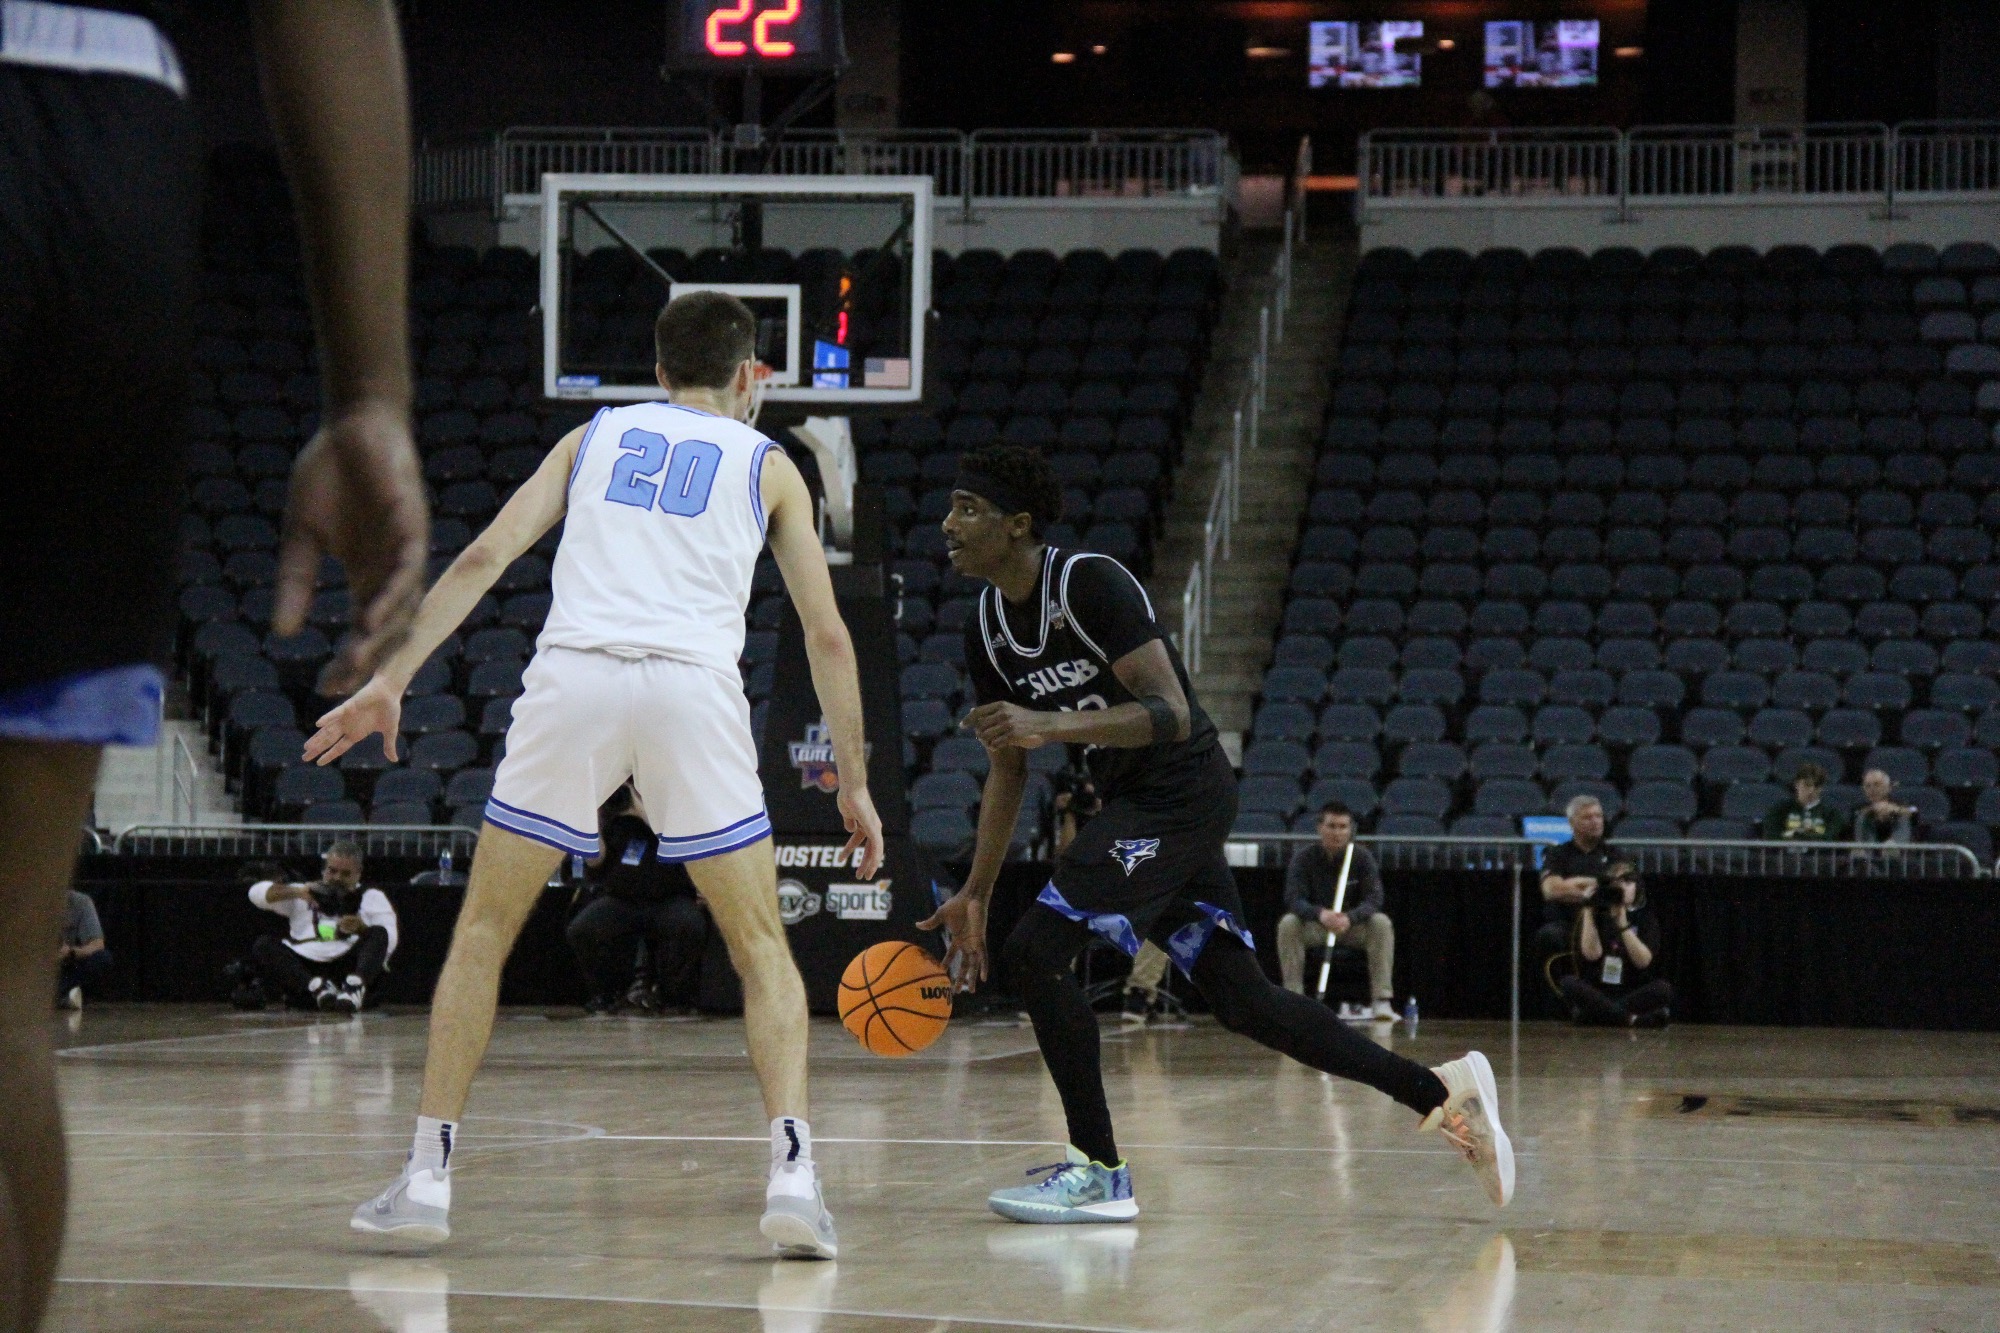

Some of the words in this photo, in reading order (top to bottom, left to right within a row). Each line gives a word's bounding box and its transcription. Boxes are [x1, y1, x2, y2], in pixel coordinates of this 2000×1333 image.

[705, 0, 800, 57] 22
[604, 427, 723, 518] 20
[826, 889, 892, 919] sports
